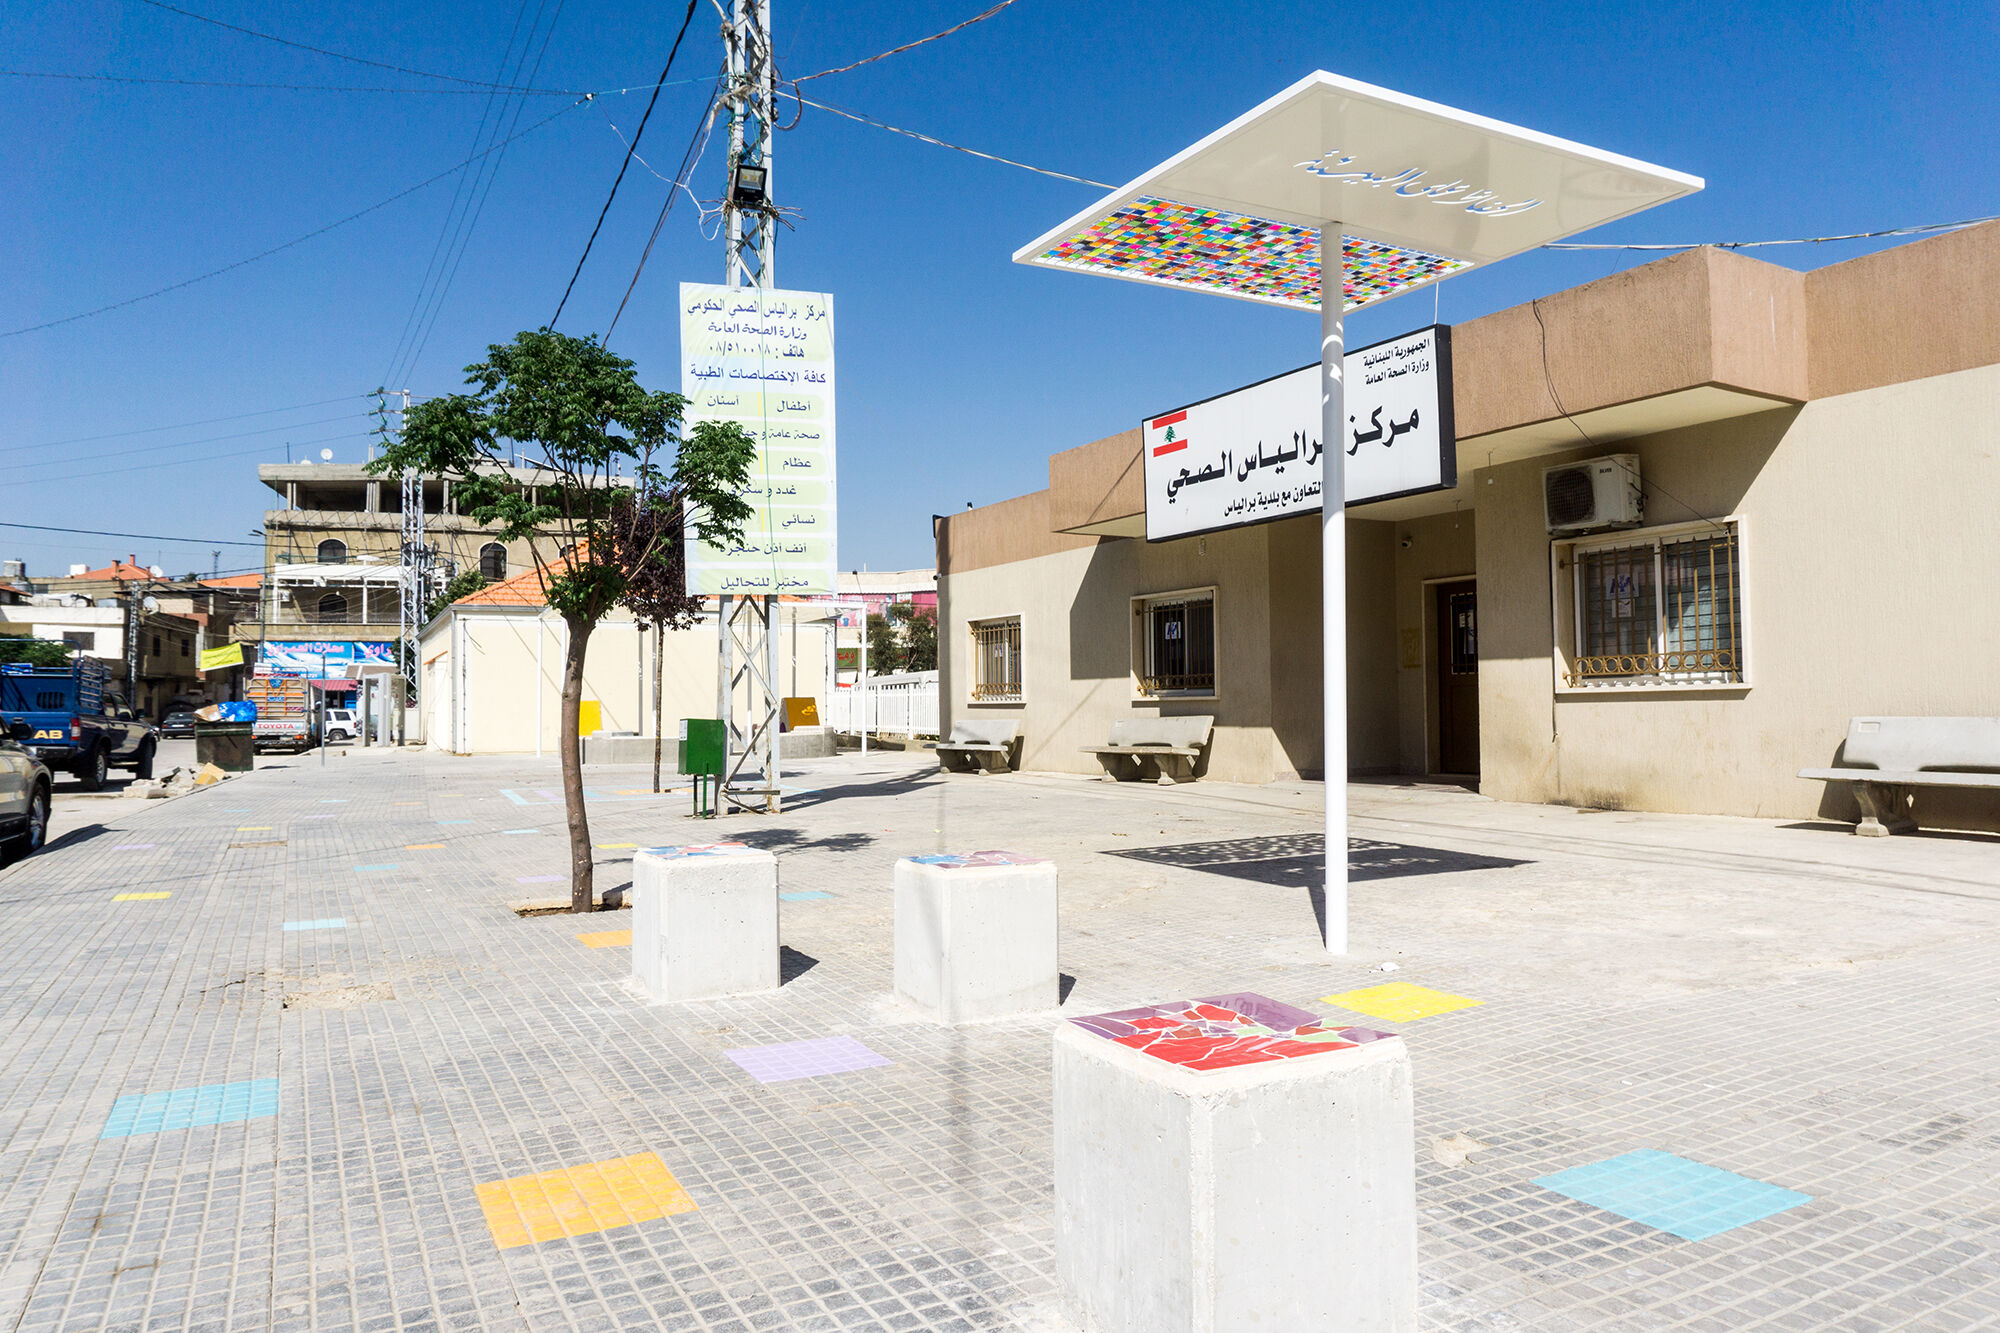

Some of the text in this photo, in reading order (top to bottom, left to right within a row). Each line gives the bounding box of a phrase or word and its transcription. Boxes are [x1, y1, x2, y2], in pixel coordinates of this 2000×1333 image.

[1293, 149, 1428, 188] البيئة
[687, 298, 725, 315] الحكومي
[728, 300, 760, 318] الصحي
[804, 304, 826, 321] مركز
[707, 321, 808, 340] وزارة الصحة العامة
[782, 344, 805, 358] هاتف
[1362, 338, 1430, 369] الجمهورية اللبنانية
[690, 363, 725, 380] الطبية
[804, 369, 826, 384] كافة
[1364, 358, 1430, 385] وزارة الصحة العامة
[706, 395, 739, 407] أسنان
[776, 400, 811, 413] أطفال
[768, 428, 791, 439] عامة
[793, 429, 820, 440] صحة
[1166, 405, 1420, 505] مركز رالياس الصحي
[782, 457, 812, 470] عظام
[775, 484, 797, 495] غدد
[1257, 490, 1280, 510] بلدية
[1281, 490, 1291, 507] مع
[781, 514, 815, 530] نسائي
[763, 542, 782, 555] أذن
[785, 542, 807, 553] أنف
[720, 576, 809, 590] مختبر للتحاليل
